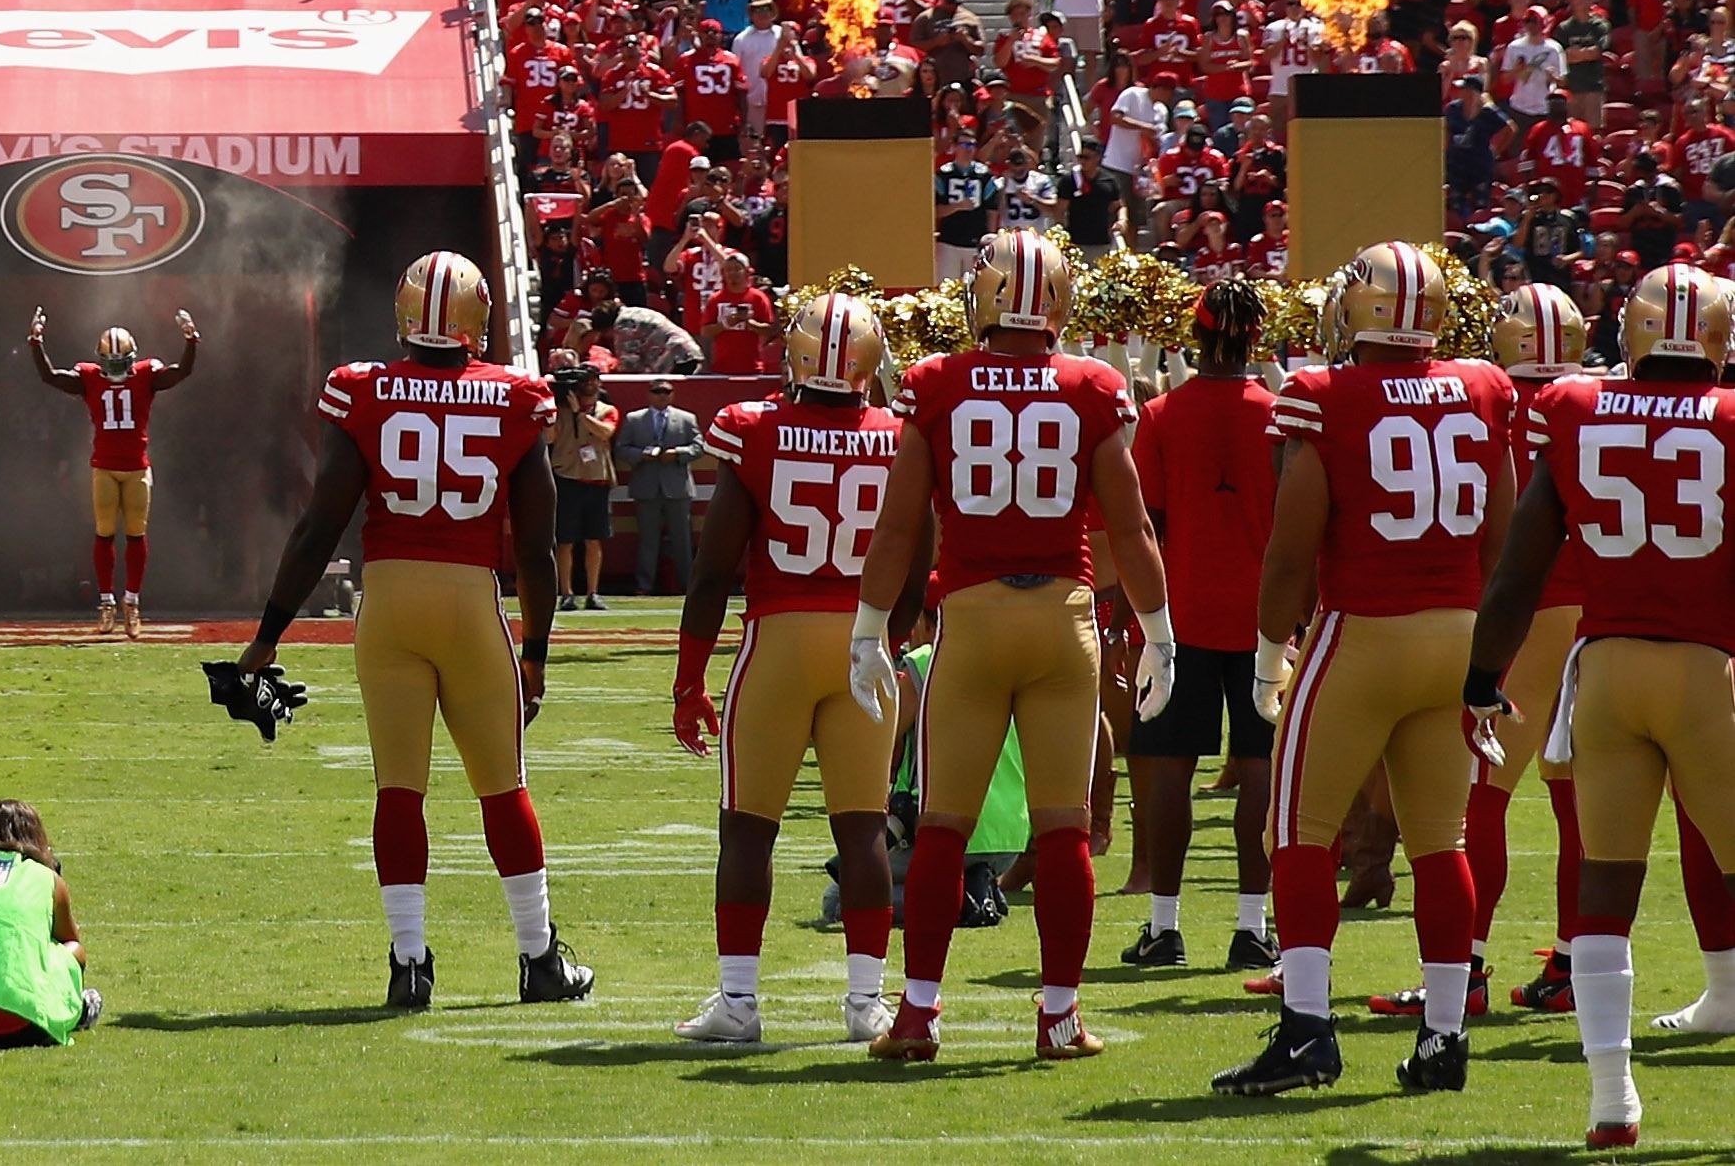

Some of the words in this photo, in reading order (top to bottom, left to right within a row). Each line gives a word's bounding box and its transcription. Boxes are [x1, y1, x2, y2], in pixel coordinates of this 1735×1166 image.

[524, 61, 557, 88] 35
[695, 65, 731, 95] 53
[777, 64, 798, 83] 53
[59, 173, 165, 257] SF
[692, 262, 723, 290] 94
[376, 376, 511, 407] CARRADINE
[971, 366, 1059, 392] CELEK
[1382, 376, 1468, 405] COOPER
[101, 389, 136, 430] 11
[1595, 390, 1719, 422] BOWMAN
[777, 425, 898, 457] DUMERVIL
[379, 411, 502, 521] 95
[950, 399, 1080, 518] 88
[1368, 412, 1489, 541] 96
[1578, 424, 1726, 559] 53
[768, 459, 889, 576] 58
[1417, 1034, 1446, 1061] NIKE
